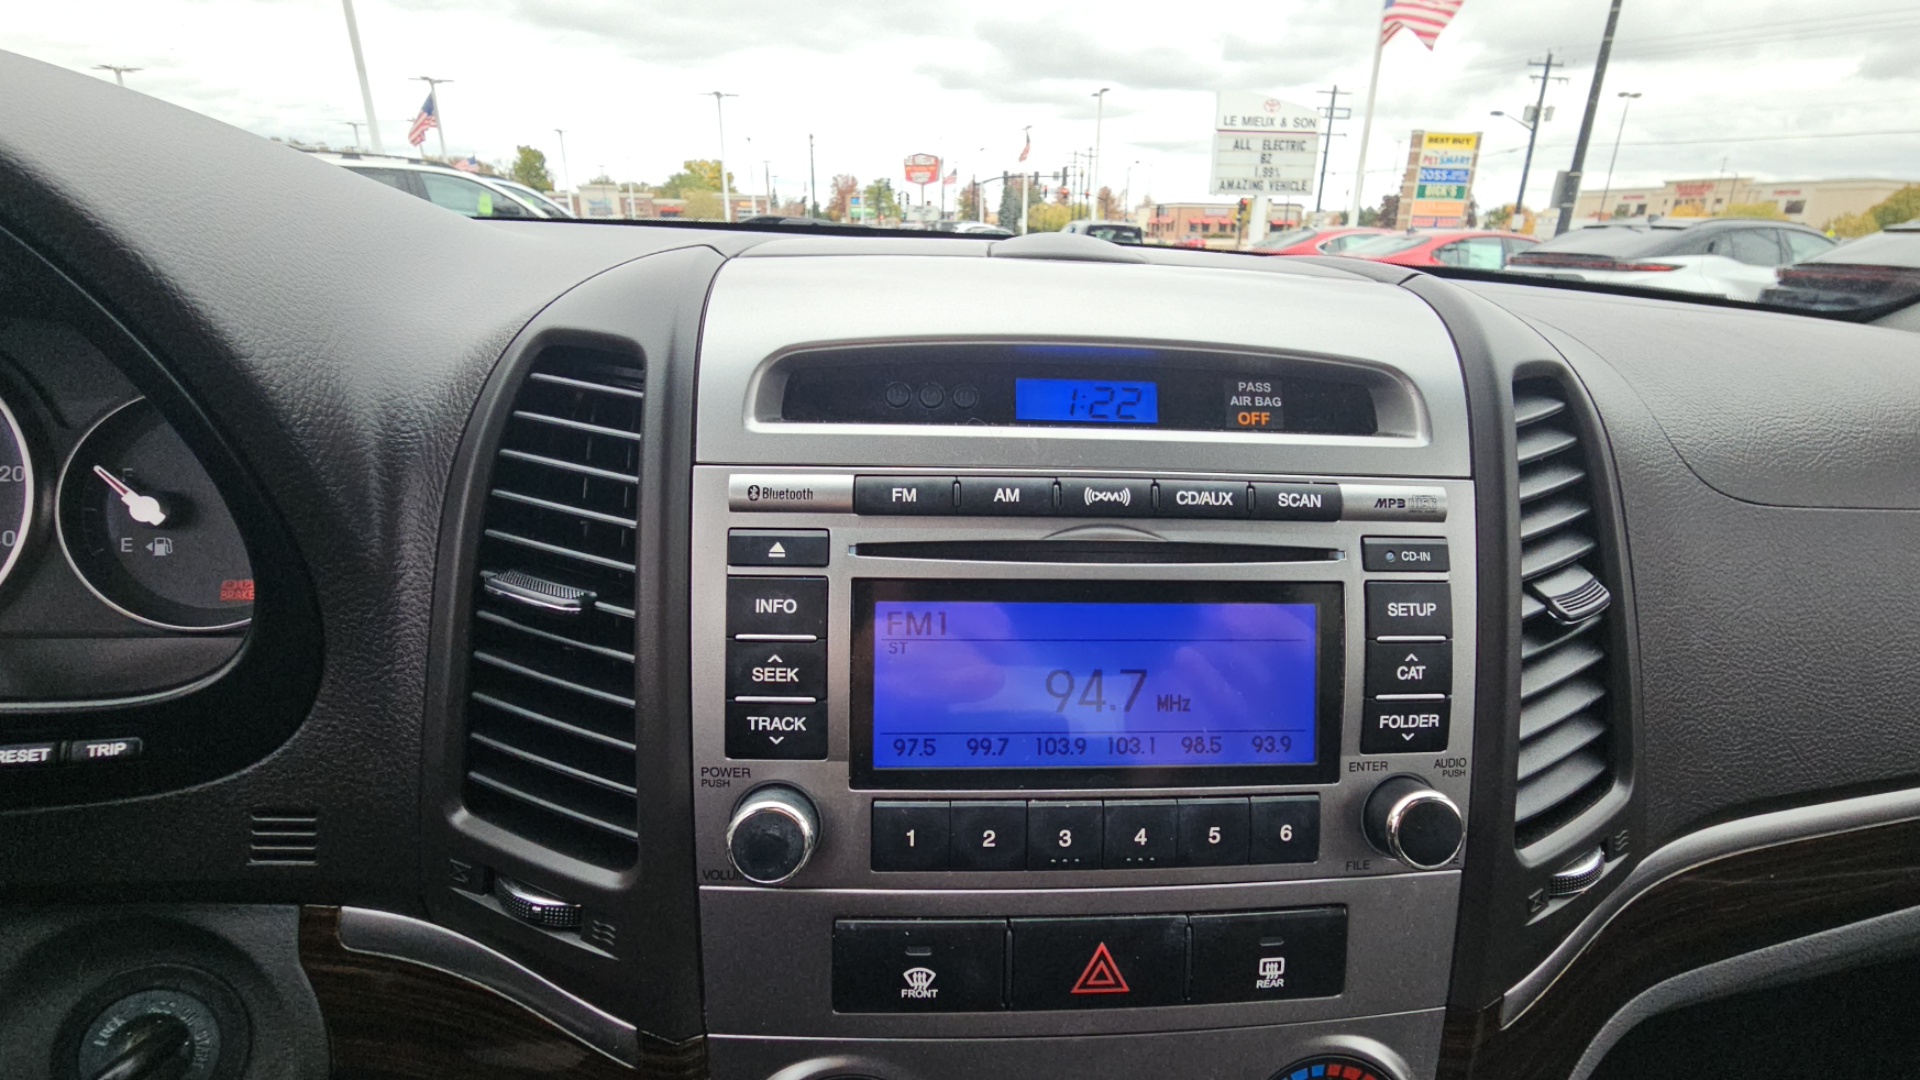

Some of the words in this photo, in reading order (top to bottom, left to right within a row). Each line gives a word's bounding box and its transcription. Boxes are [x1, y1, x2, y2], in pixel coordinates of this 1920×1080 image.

[1223, 115, 1237, 126] LE
[1242, 116, 1275, 127] MIEUX
[1293, 117, 1317, 128] SON
[1233, 139, 1251, 150] ALL
[1262, 139, 1306, 151] ELECTRIC
[1428, 136, 1450, 144] BEST
[1452, 137, 1472, 145] BUY
[1219, 179, 1263, 191] AMAZING
[1269, 180, 1307, 192] VEHICLE
[1238, 382, 1271, 393] PASS
[1069, 386, 1142, 420] 1:22
[1230, 396, 1251, 407] AIR
[1255, 396, 1282, 408] BAG
[1237, 412, 1271, 426] OFF
[762, 487, 814, 500] Bluetooth
[892, 488, 917, 502] FM
[993, 488, 1020, 502] AM
[1176, 491, 1233, 507] CD/AUX
[1278, 493, 1322, 508] SCAN
[1374, 498, 1405, 509] MP3
[121, 538, 133, 552] E
[1401, 551, 1431, 562] CD-IN
[755, 599, 797, 614] INFO
[1388, 603, 1436, 617] SETUP
[887, 610, 947, 636] FM1
[888, 641, 908, 655] ST
[752, 668, 799, 682] SEEK
[1397, 666, 1425, 680] CAT
[1045, 669, 1148, 713] 94.7
[1157, 695, 1191, 713] MHz
[747, 716, 806, 731] TRACK
[1379, 715, 1439, 729] FOLDER
[87, 742, 127, 757] TRIP
[892, 738, 937, 757] 97.5
[966, 738, 1009, 757] 99.7
[1035, 737, 1087, 756] 103.9
[1108, 737, 1156, 756] 103.1
[1181, 736, 1222, 754] 98.5
[1251, 736, 1292, 754] 93.9
[0, 748, 51, 763] RESET
[1349, 761, 1388, 773] ENTER
[1434, 758, 1467, 770] AUDIO
[700, 767, 751, 778] POWER
[1442, 769, 1466, 778] PUSH
[701, 779, 730, 788] PUSH
[906, 829, 916, 848] 1
[982, 829, 997, 848] 2
[1058, 829, 1072, 848] 3
[1134, 828, 1148, 846] 4
[1208, 826, 1221, 845] 5
[1279, 824, 1293, 842] 6
[1346, 860, 1370, 871] FILE
[1256, 978, 1284, 989] REAR
[901, 989, 938, 999] FRONT
